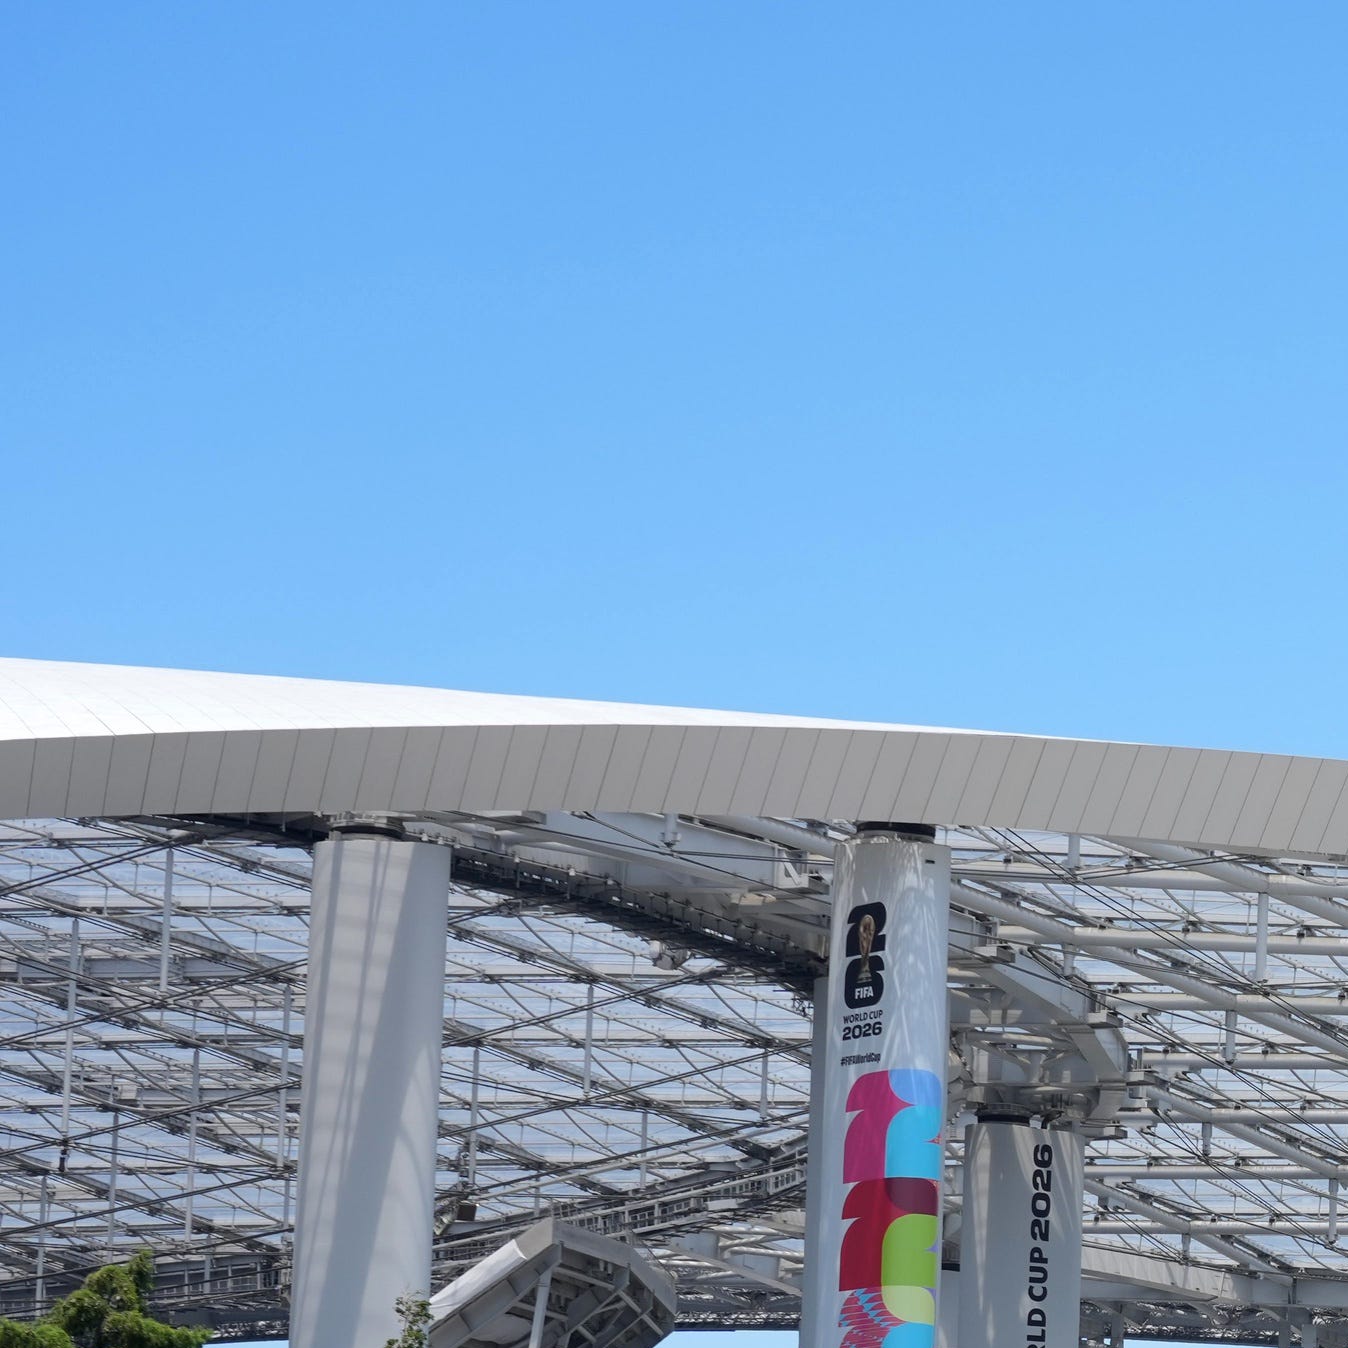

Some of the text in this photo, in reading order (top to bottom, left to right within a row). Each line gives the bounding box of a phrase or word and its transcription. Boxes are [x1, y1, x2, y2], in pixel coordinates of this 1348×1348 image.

[855, 986, 874, 999] FIFA
[843, 1009, 883, 1024] WORLD CUP
[842, 1022, 883, 1041] 2026
[840, 1052, 881, 1067] #FIFAWorldCup
[1030, 1143, 1054, 1242] 2026
[1028, 1246, 1049, 1304] CUP
